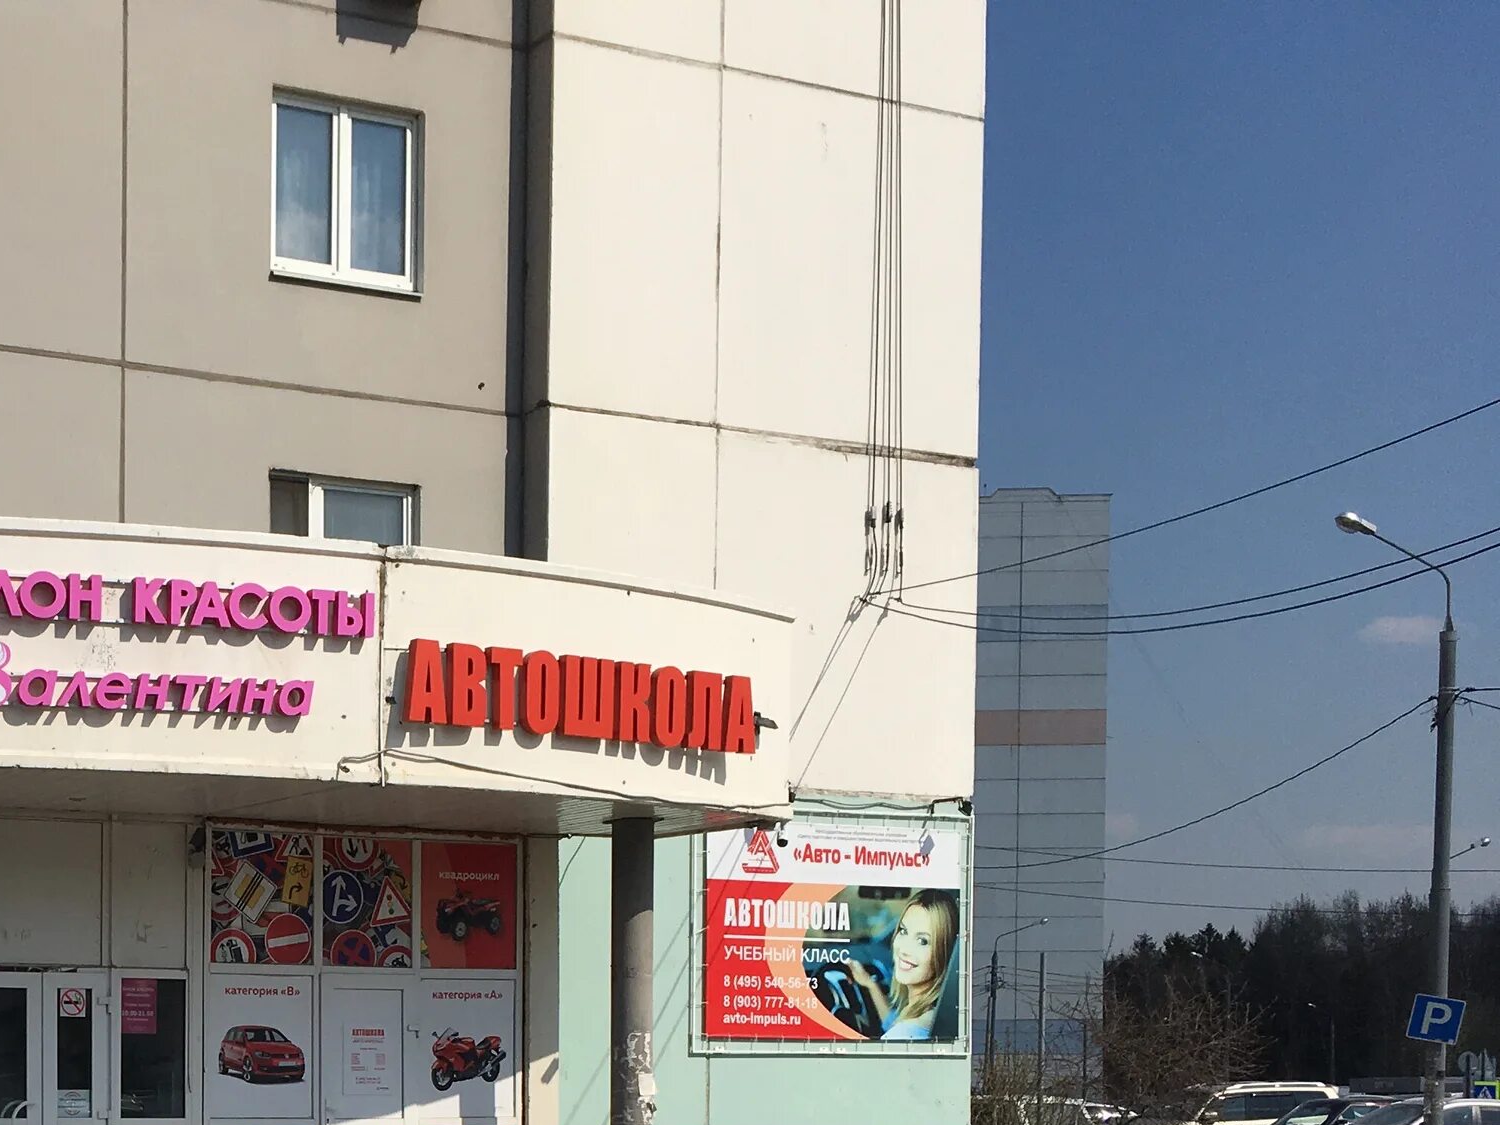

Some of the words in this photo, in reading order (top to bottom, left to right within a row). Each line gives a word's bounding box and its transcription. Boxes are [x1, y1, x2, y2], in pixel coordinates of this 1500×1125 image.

[132, 577, 375, 638] КРАСОТЫ
[408, 638, 756, 755] АВТОШКОЛА
[793, 843, 841, 865] «Авто
[854, 846, 931, 871] Импульс»
[438, 871, 500, 883] квадроцикл
[724, 898, 850, 931] АВТОШКОЛА
[724, 945, 796, 963] УЧЕБНЫЙ
[801, 948, 850, 964] КЛАСС
[723, 975, 731, 987] 8
[733, 975, 761, 990] (495)
[764, 976, 818, 990] 540-56-73
[224, 986, 276, 998] категория
[432, 989, 482, 1001] категория
[723, 995, 731, 1007] 8
[733, 995, 761, 1010] (903)
[723, 1012, 801, 1027] avto-impuls.ru
[1420, 1001, 1452, 1035] P
